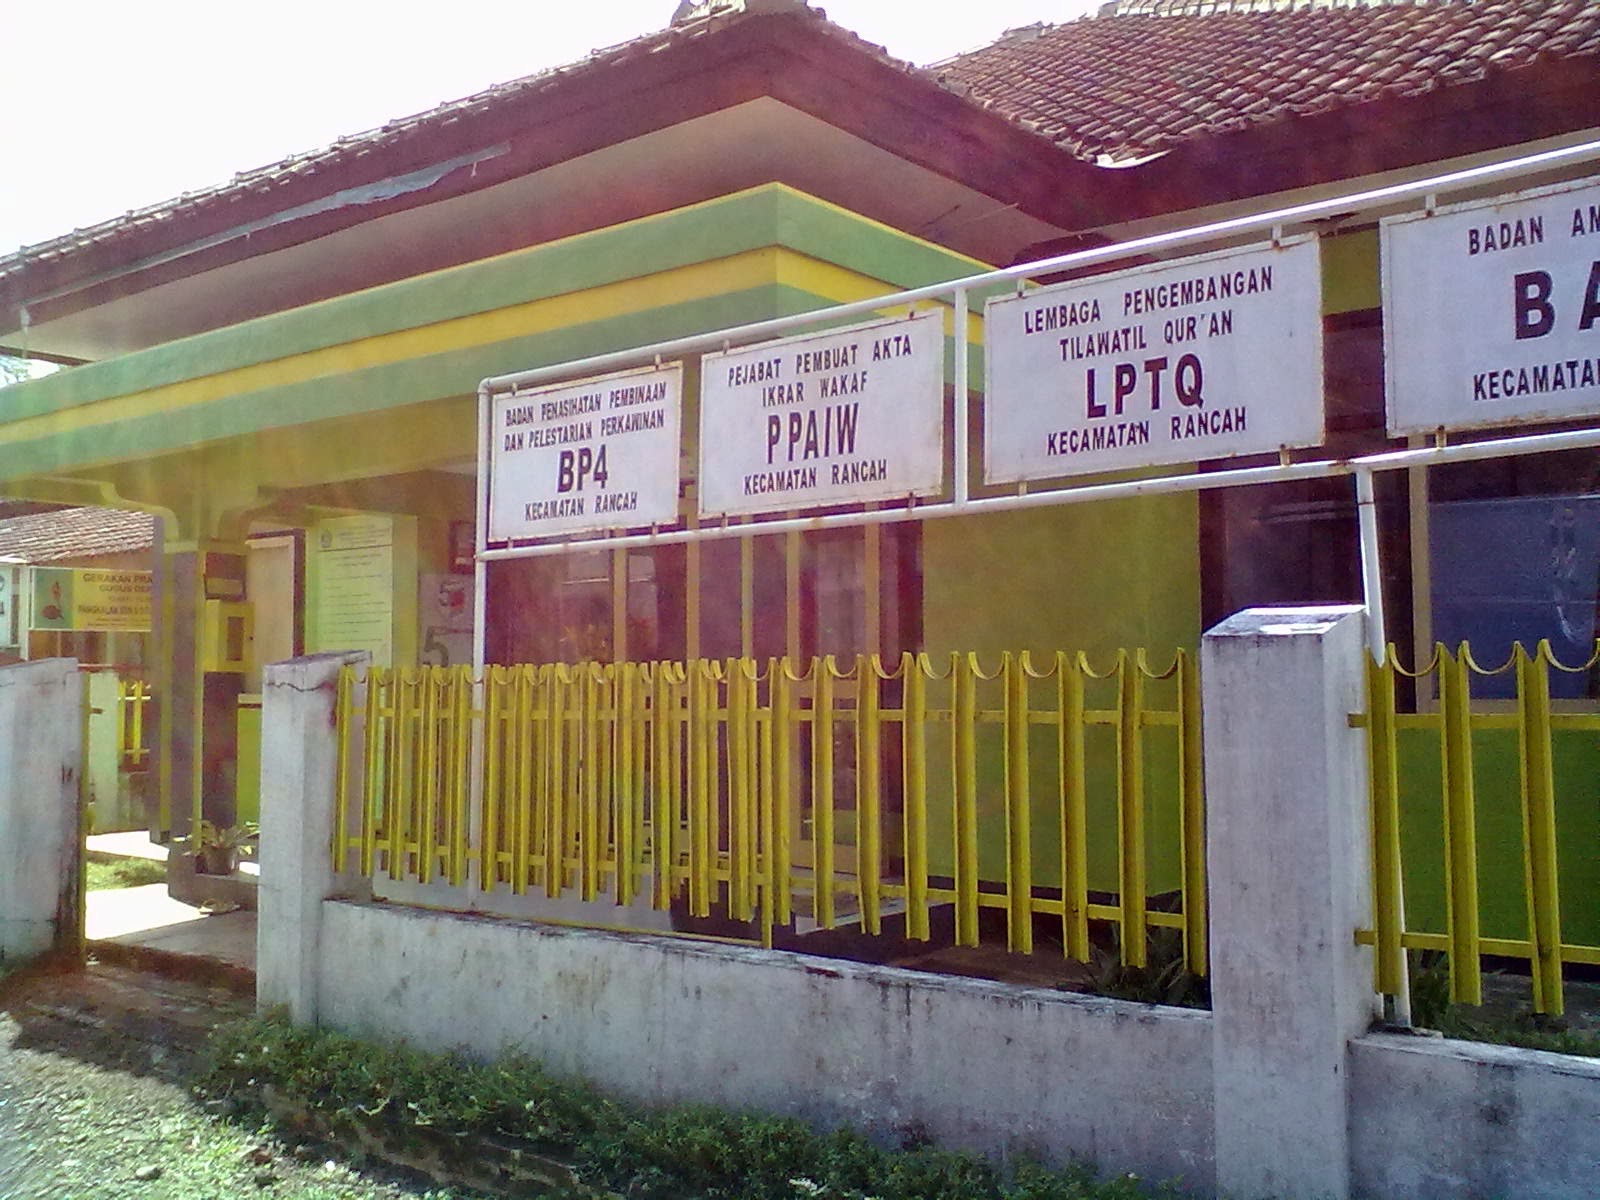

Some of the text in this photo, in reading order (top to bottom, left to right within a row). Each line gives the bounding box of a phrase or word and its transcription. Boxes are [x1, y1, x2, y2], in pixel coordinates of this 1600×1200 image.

[1468, 216, 1544, 255] BADAN
[1025, 266, 1273, 334] LEMBAGA PENGEMBANGAN
[728, 334, 912, 387] PEJABAT PEMBUAT AKTA
[1060, 325, 1147, 361] TILAWATIL
[762, 371, 867, 407] IKRAR WAKAF
[1087, 353, 1204, 418] LPTQ
[1473, 358, 1600, 401] KECAMATA
[506, 382, 666, 427] BADAN PENASIHATAN PEMBINAAN
[504, 409, 664, 451] DAN PELESTARIAN PERKAWINAN
[767, 402, 859, 464] PPAIW
[1047, 406, 1247, 456] KECAMATAN RANCAH
[557, 444, 608, 493] BP4
[744, 459, 887, 495] KECAMATAN RANCAH
[525, 492, 638, 521] KECAMATAN RANCAH
